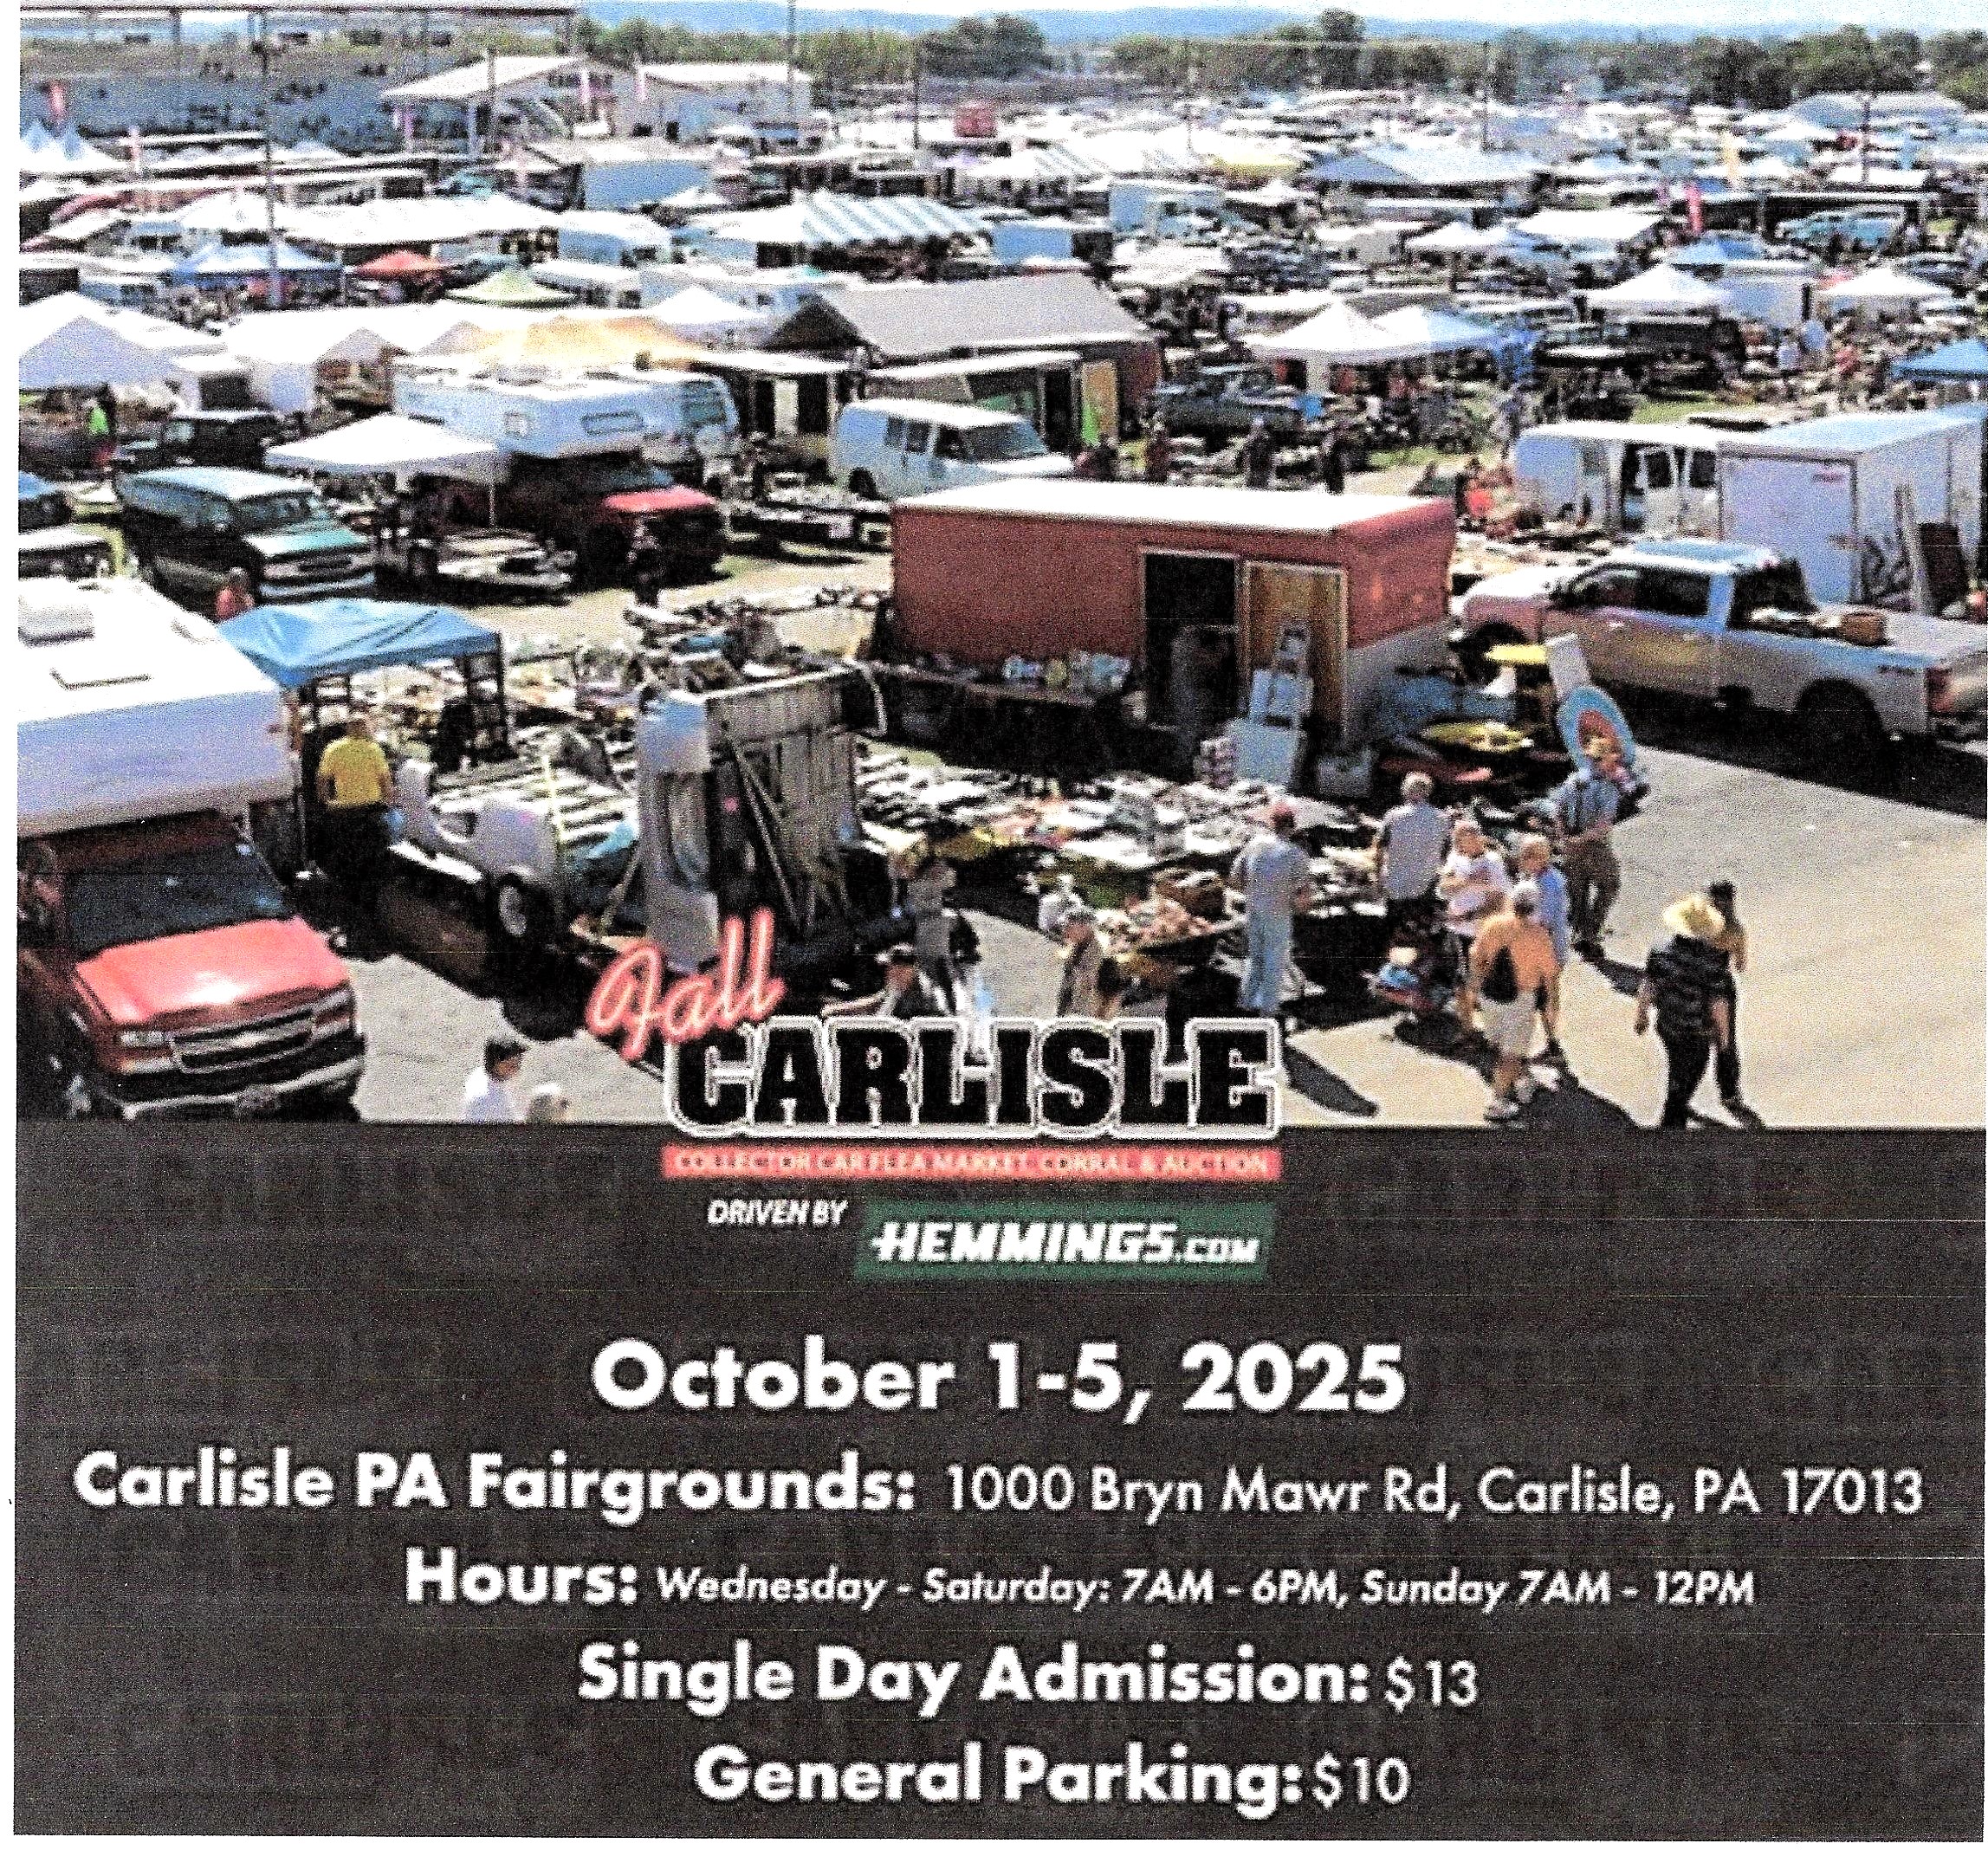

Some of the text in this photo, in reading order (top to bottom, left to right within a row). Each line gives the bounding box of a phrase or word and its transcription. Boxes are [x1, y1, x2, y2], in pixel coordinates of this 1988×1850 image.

[584, 906, 787, 1061] Fall
[667, 1017, 1281, 1134] CARLISLE
[675, 1153, 812, 1172] COLLECTOR
[816, 1153, 864, 1172] CAR
[868, 1153, 928, 1172] FLEA
[1039, 1154, 1136, 1173] CORRAL
[1143, 1154, 1159, 1173] &
[1163, 1154, 1268, 1174] AUCTION
[706, 1199, 849, 1226] DRIVEN BY
[592, 1334, 955, 1411] October
[988, 1342, 1151, 1424] 1-5,
[1182, 1342, 1406, 1413] 2025
[74, 1446, 1922, 1526] Carlisle PA Fairgrounds: 1000 Bryn Mawr Rd, Carlisle, PA 17013
[406, 1546, 638, 1605] Hours:
[657, 1565, 887, 1611] Wednesday
[923, 1566, 1110, 1612] Saturday:
[1122, 1568, 1214, 1602] 7AM
[1252, 1569, 1348, 1608] 6PM,
[1361, 1568, 1508, 1614] Sunday
[1519, 1569, 1610, 1604] 7AM
[1655, 1570, 1755, 1604] 12PM
[579, 1640, 1477, 1718] Single Day Admission: $13
[695, 1742, 1409, 1820] General Parking: $10
